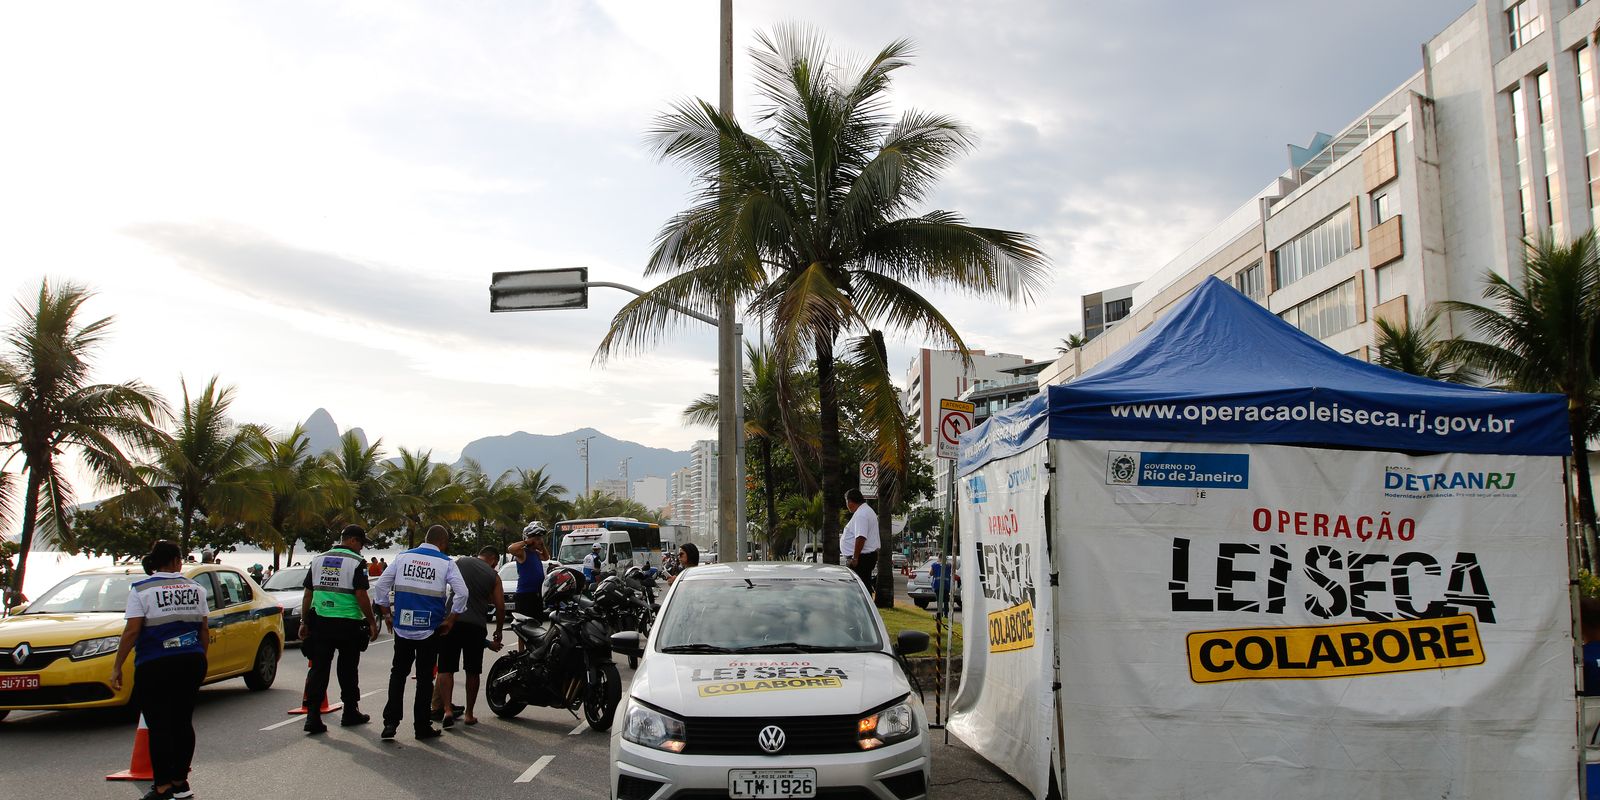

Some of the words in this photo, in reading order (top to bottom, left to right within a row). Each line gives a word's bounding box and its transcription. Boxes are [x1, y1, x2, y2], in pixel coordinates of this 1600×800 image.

[1111, 401, 1516, 436] www.operacaoleiseca.rj.gov.br
[1143, 470, 1166, 481] Rio
[1168, 470, 1186, 481] de
[1188, 471, 1243, 483] Janeiro
[1252, 508, 1416, 542] OPERAÇÃO
[403, 563, 415, 577] LEI
[416, 565, 436, 580] SECA
[1168, 537, 1292, 615] LEI
[1304, 545, 1497, 624] SECA
[156, 590, 173, 608] LEI
[174, 588, 199, 606] SECA
[988, 610, 1033, 647] COLABORE
[1199, 623, 1475, 674] COLABORE
[0, 678, 38, 689] SU-7130
[692, 667, 748, 681] LEI
[753, 666, 849, 680] SECA
[704, 678, 837, 694] COLABORE
